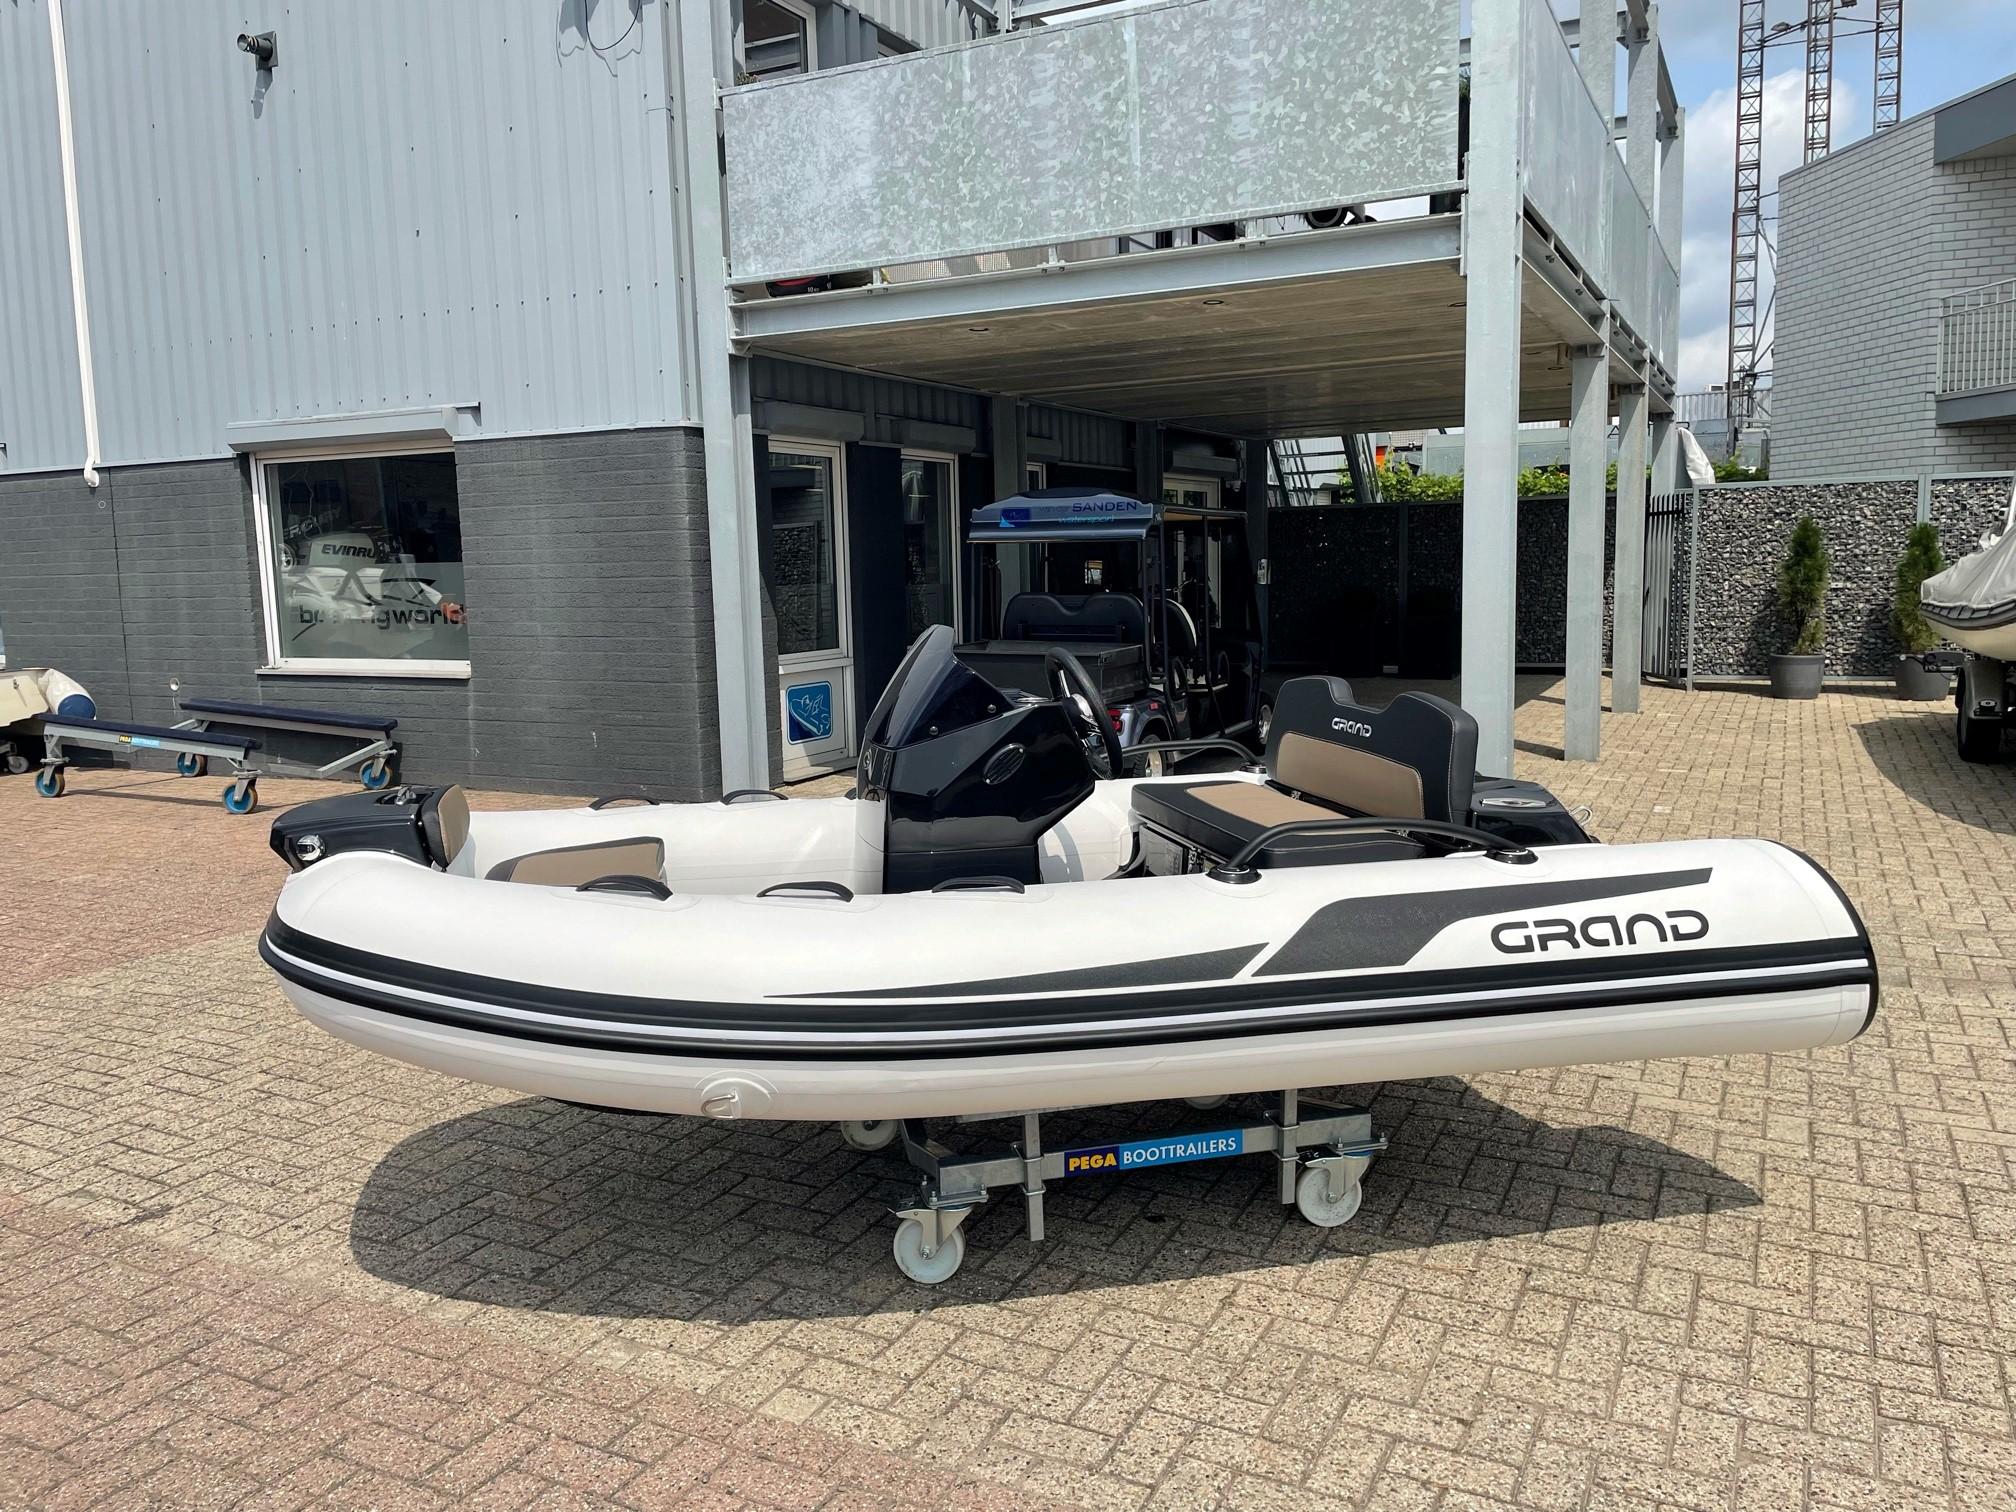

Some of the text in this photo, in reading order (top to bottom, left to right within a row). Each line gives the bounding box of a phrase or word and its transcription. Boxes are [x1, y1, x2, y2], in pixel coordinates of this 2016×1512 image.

[1072, 501, 1137, 512] SANDEN
[1331, 717, 1372, 738] GRAND
[1490, 909, 1709, 954] GRAND
[1069, 1137, 1237, 1172] PEGA BOOTTRAILERS
